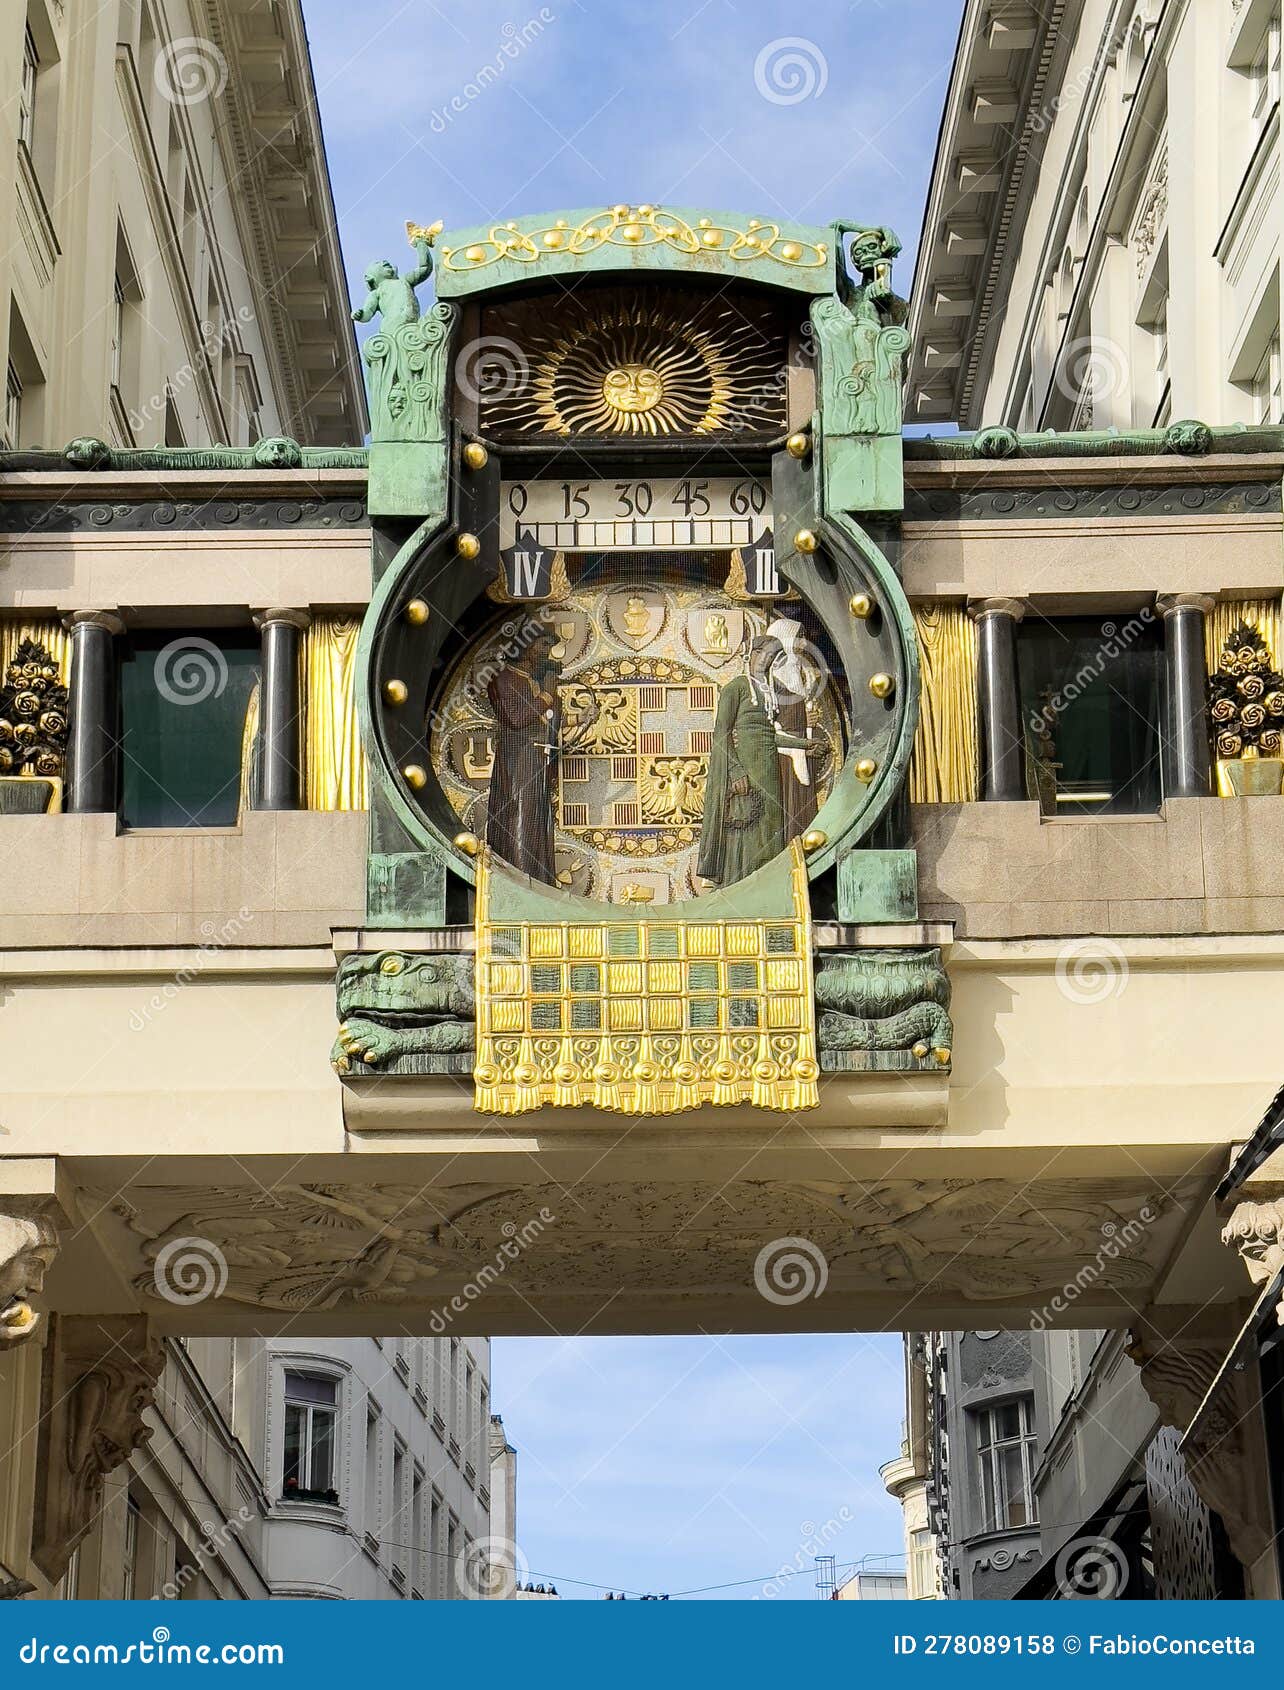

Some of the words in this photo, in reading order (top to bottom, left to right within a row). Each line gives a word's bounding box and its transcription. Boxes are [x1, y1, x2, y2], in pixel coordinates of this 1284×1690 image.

[509, 483, 528, 517] 0
[561, 483, 590, 519] 15
[614, 482, 653, 518] 30
[671, 480, 711, 517] 45
[730, 480, 766, 516] 60
[513, 551, 541, 596] IV
